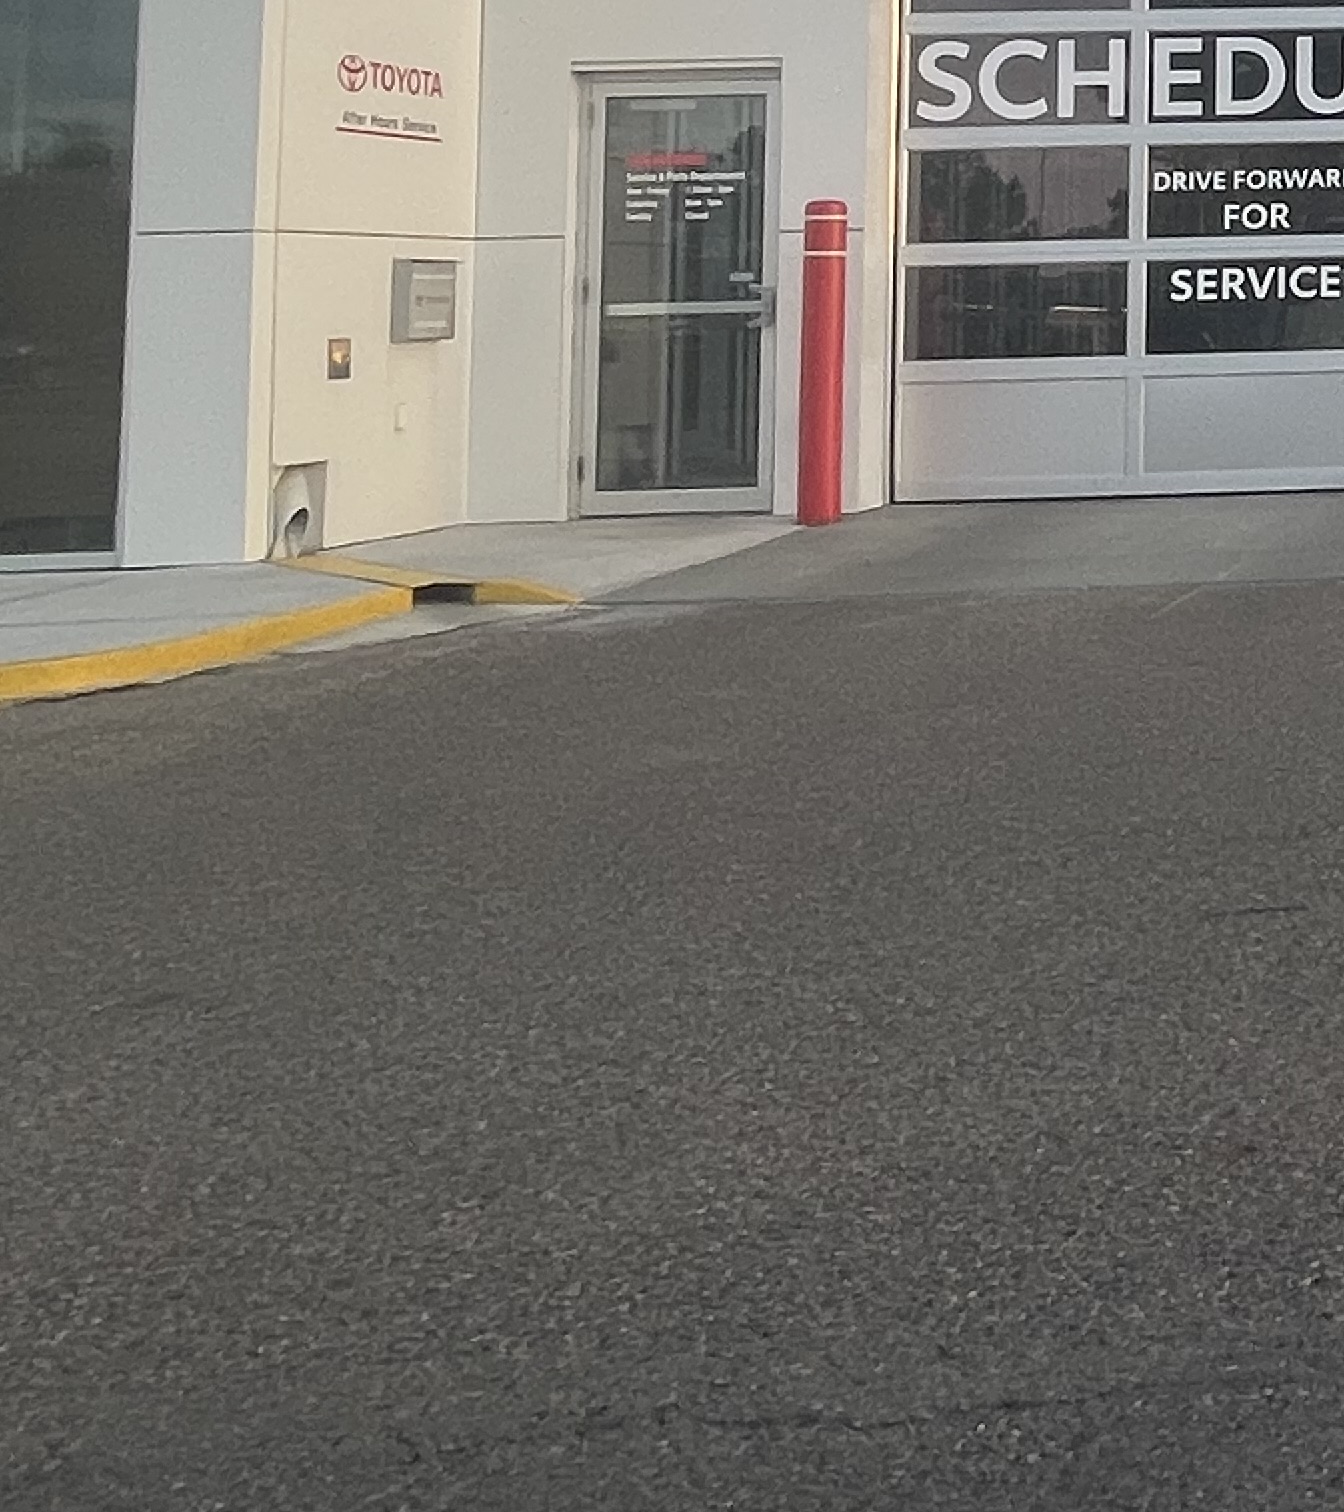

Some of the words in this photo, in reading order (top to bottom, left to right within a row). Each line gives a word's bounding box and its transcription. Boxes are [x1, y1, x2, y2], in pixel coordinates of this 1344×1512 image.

[368, 60, 444, 99] TOYOTA
[1153, 170, 1227, 193] DRIVE
[1223, 203, 1291, 230] FOR
[1169, 264, 1342, 302] SERVICE
